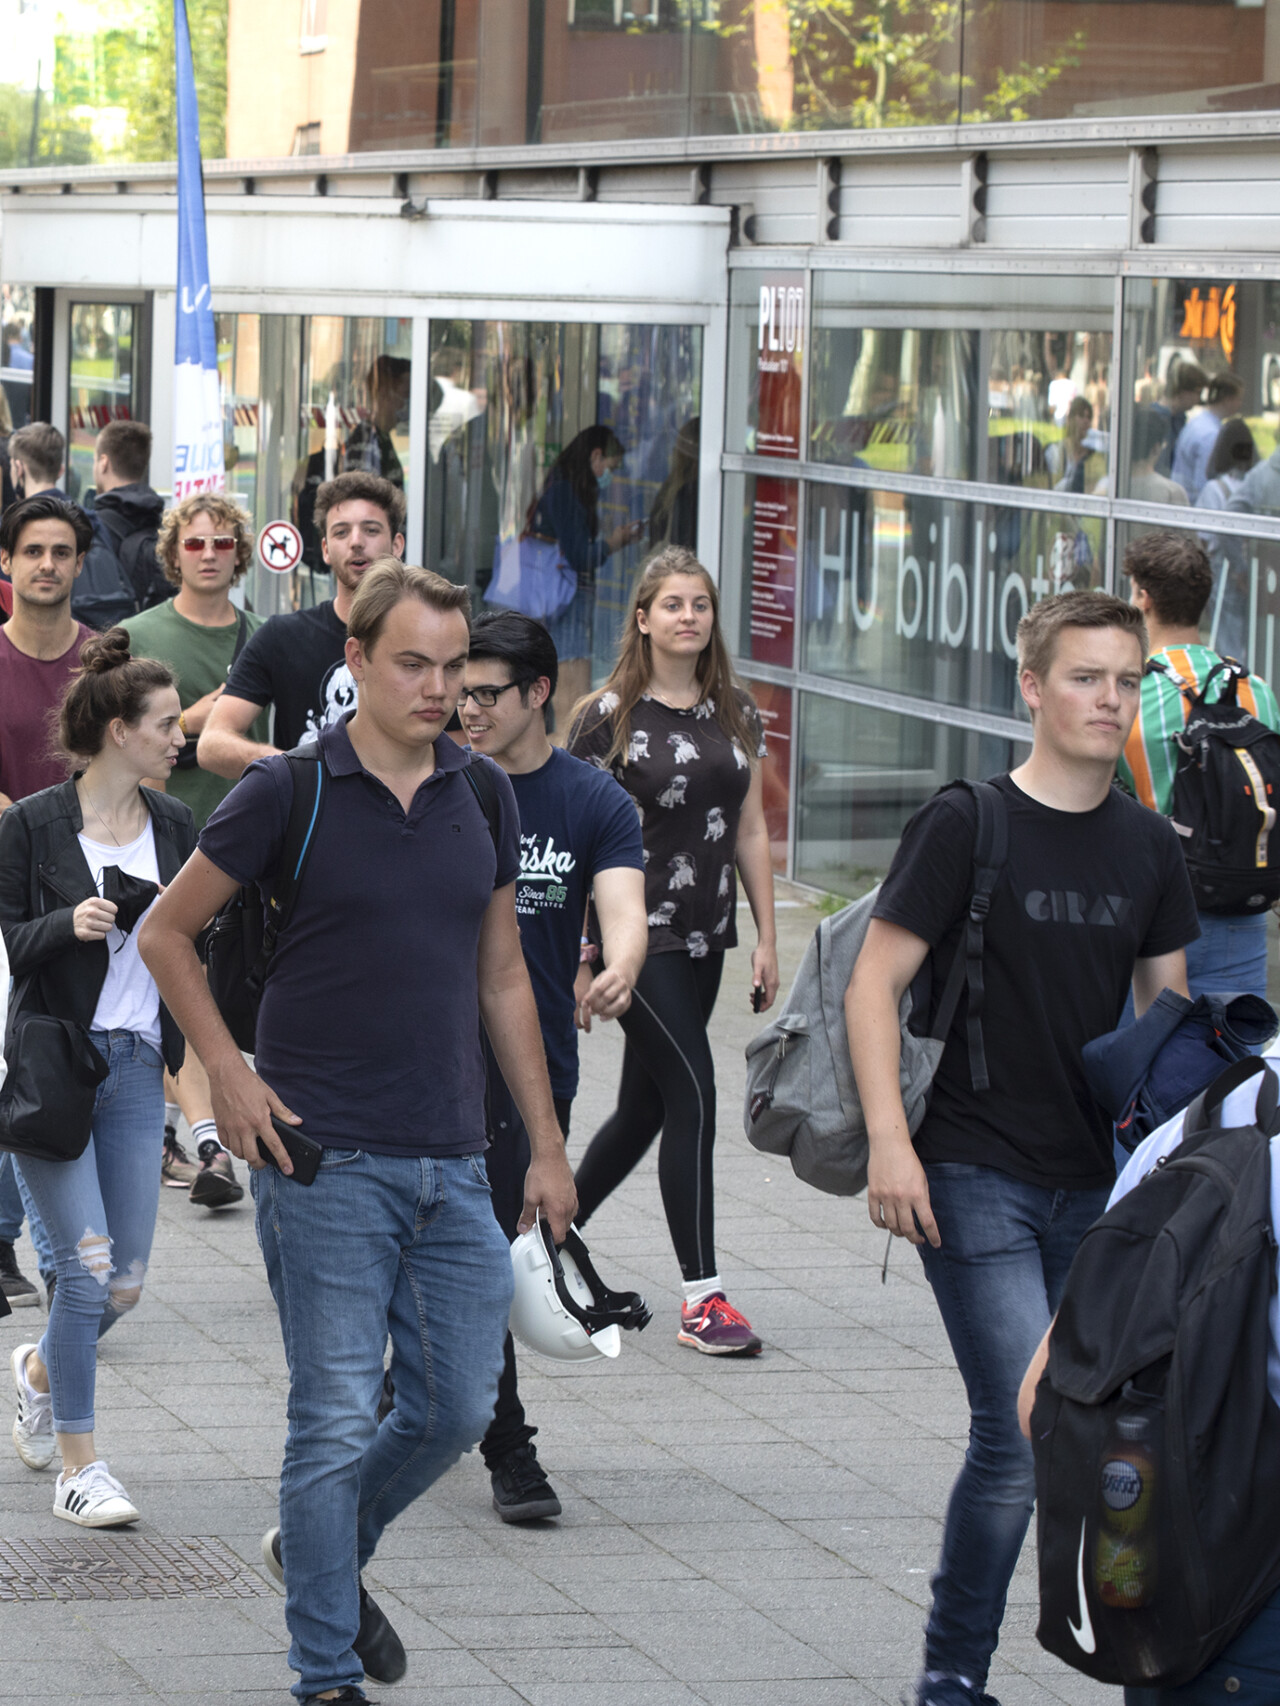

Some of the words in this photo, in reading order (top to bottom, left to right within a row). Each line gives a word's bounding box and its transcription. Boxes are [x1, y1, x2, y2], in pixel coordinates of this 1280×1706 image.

[818, 506, 880, 632] HU
[518, 885, 545, 900] Since
[545, 884, 568, 903] 85
